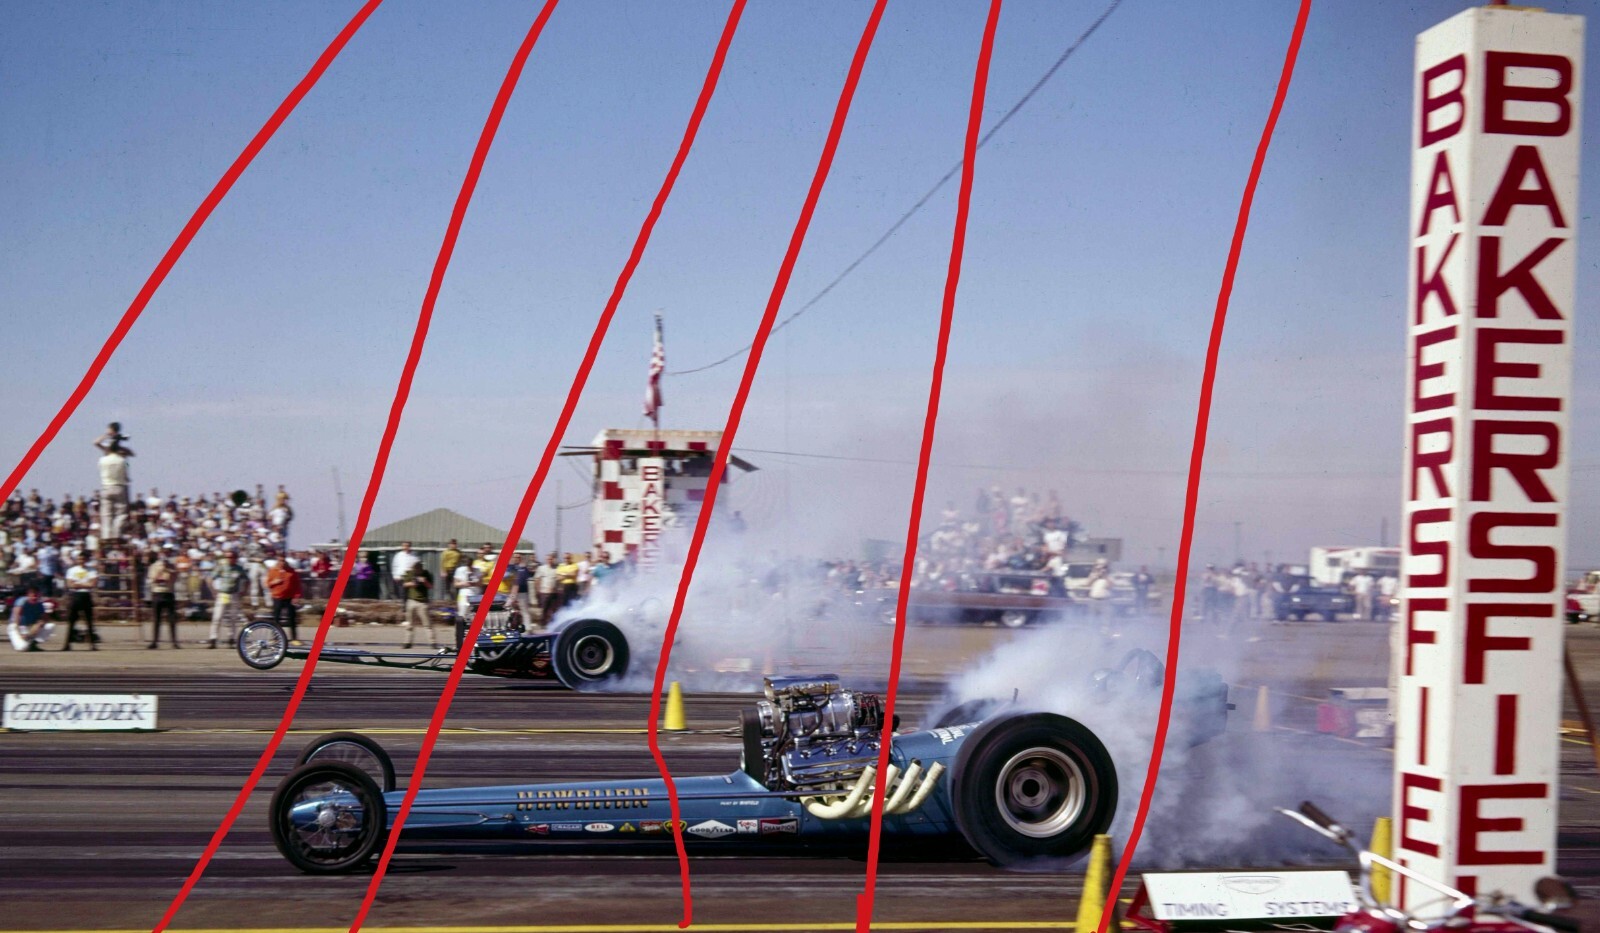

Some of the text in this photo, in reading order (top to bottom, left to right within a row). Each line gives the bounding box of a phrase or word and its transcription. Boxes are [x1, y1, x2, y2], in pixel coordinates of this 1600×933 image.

[10, 702, 149, 721] CHRONDEK
[690, 826, 734, 834] GOODYEAR
[763, 824, 796, 832] CHAMPION
[1163, 901, 1351, 917] TIMING SYSTEMS
